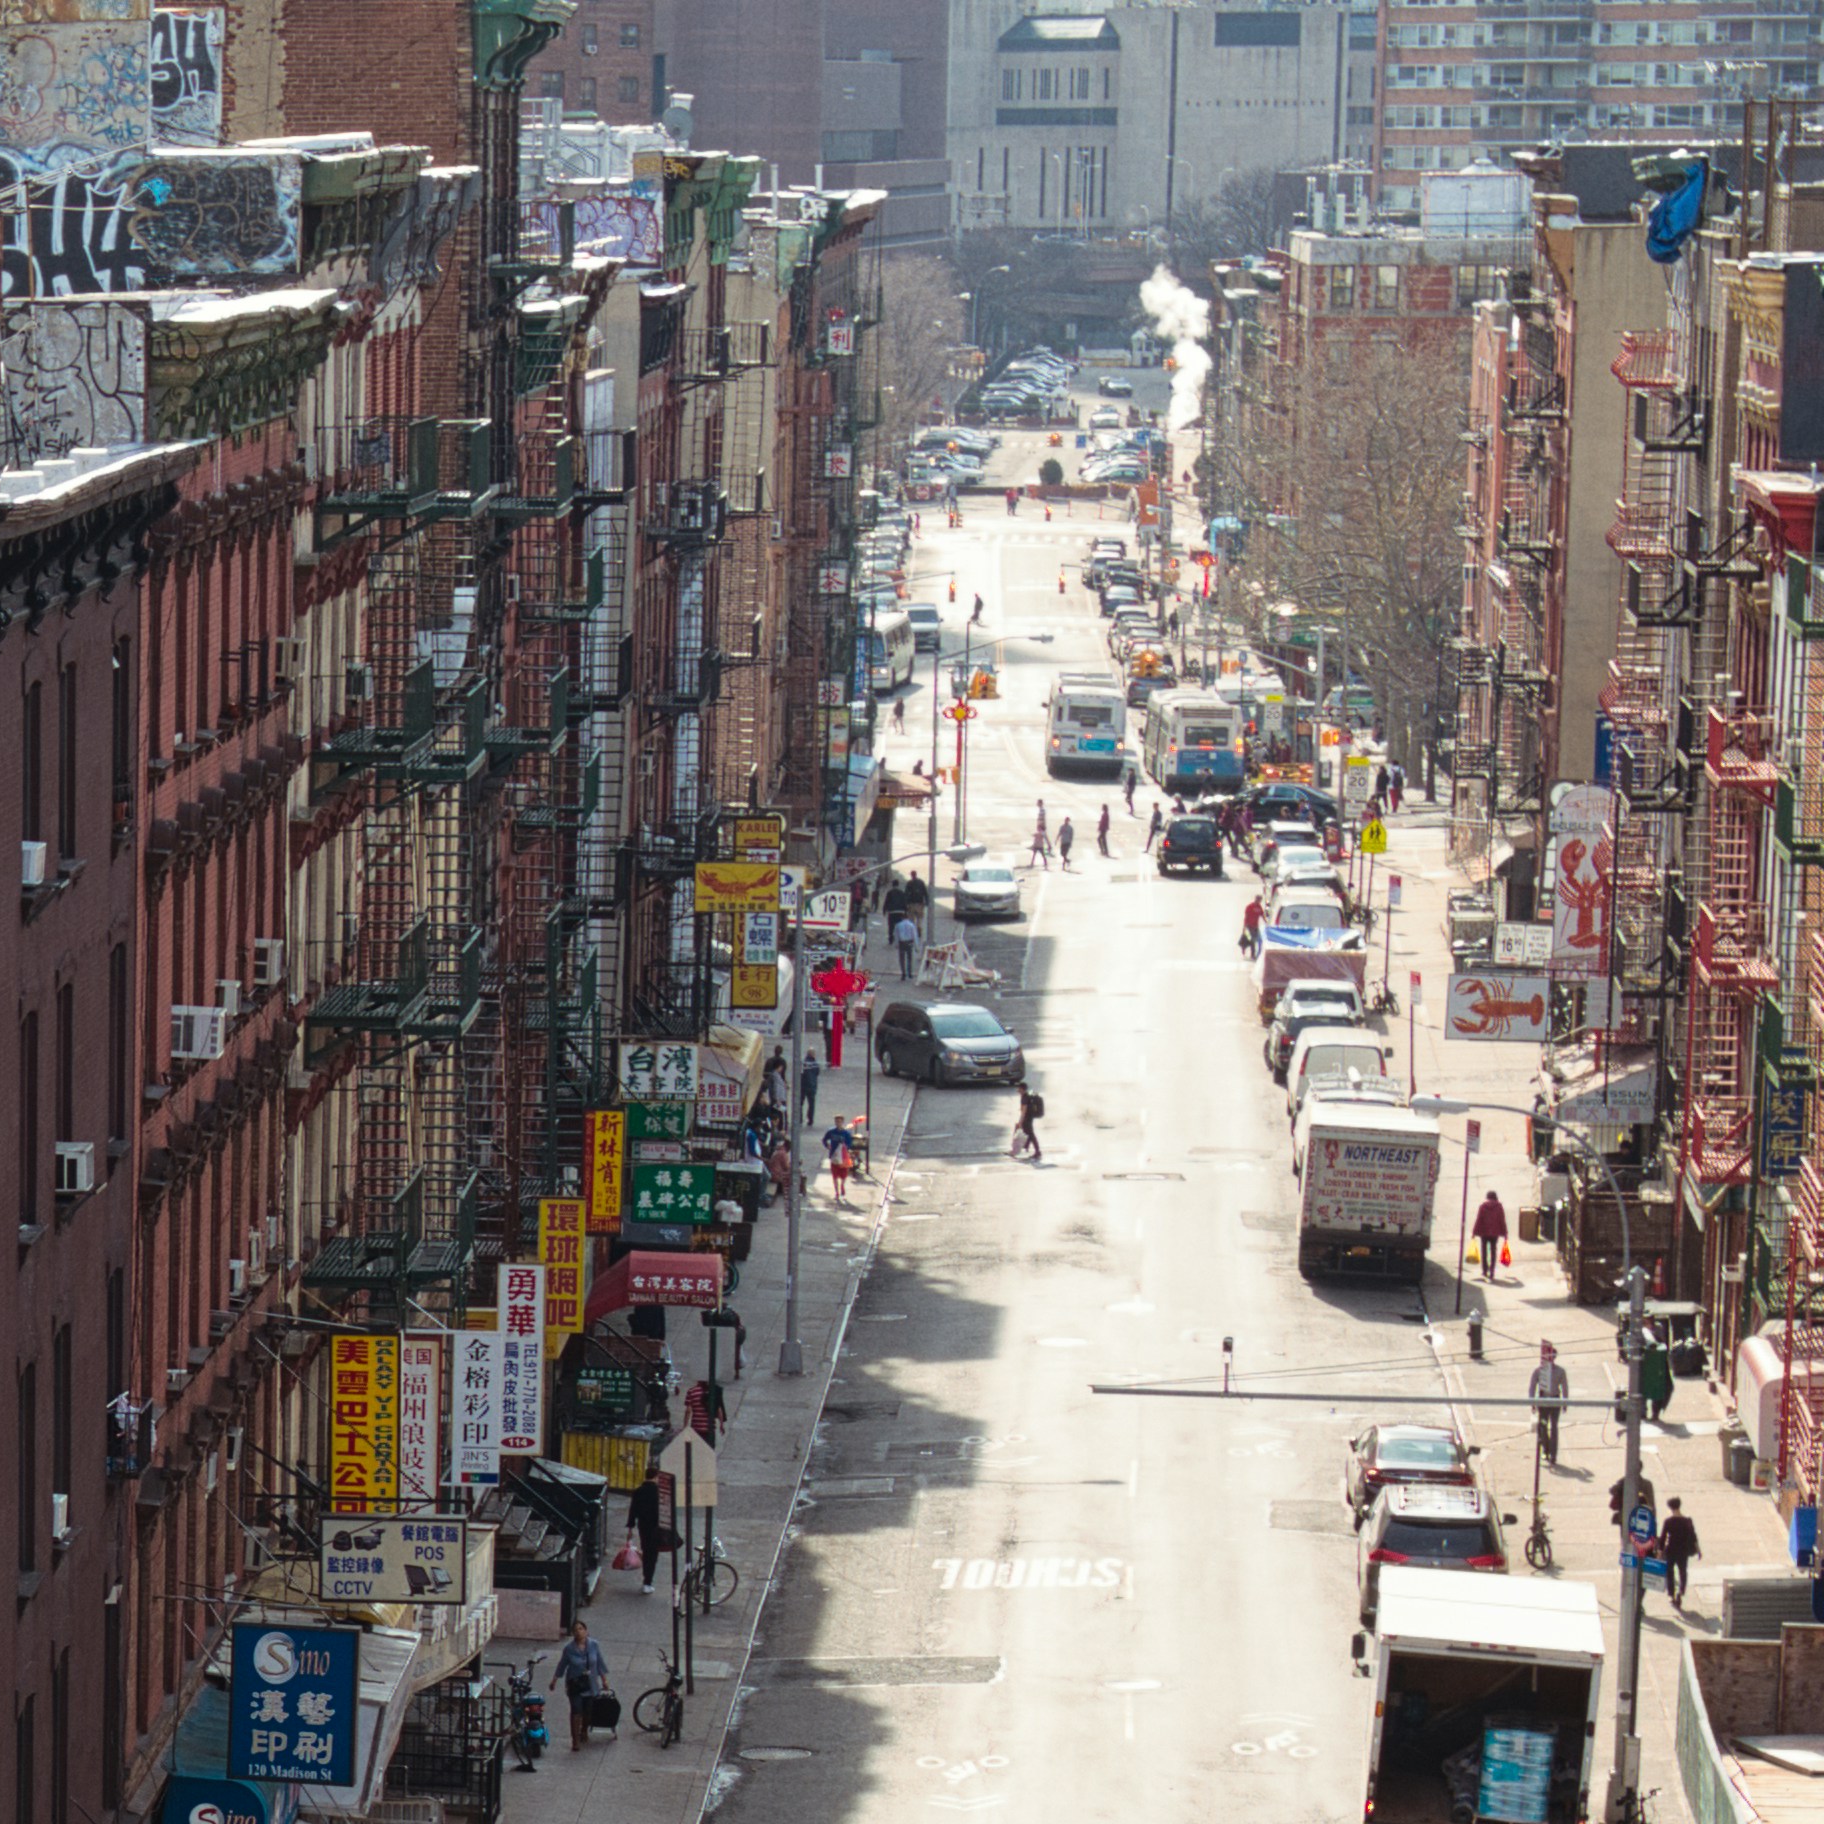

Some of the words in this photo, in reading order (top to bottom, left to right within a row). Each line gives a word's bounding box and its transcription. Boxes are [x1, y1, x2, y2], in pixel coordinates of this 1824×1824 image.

[1351, 775, 1367, 788] 20
[737, 821, 779, 833] KARLEE
[628, 1045, 693, 1074] 台灣
[1344, 1146, 1421, 1164] NORTHEAST
[545, 1203, 580, 1327] 環球網吧
[632, 1275, 714, 1292] 台灣美容院
[507, 1268, 537, 1337] 勇華
[462, 1338, 491, 1445] 金榕彩印
[507, 1438, 528, 1448] 114
[461, 1451, 490, 1462] JIN'S
[414, 1546, 445, 1561] POS
[932, 1557, 1124, 1590] SCHOOL
[333, 1580, 374, 1596] CCTV
[258, 1639, 331, 1676] Sino
[250, 1689, 336, 1726] 漢藝
[250, 1728, 334, 1765] 印刷
[248, 1763, 267, 1776] 120
[270, 1764, 318, 1780] Madison
[320, 1767, 333, 1781] St
